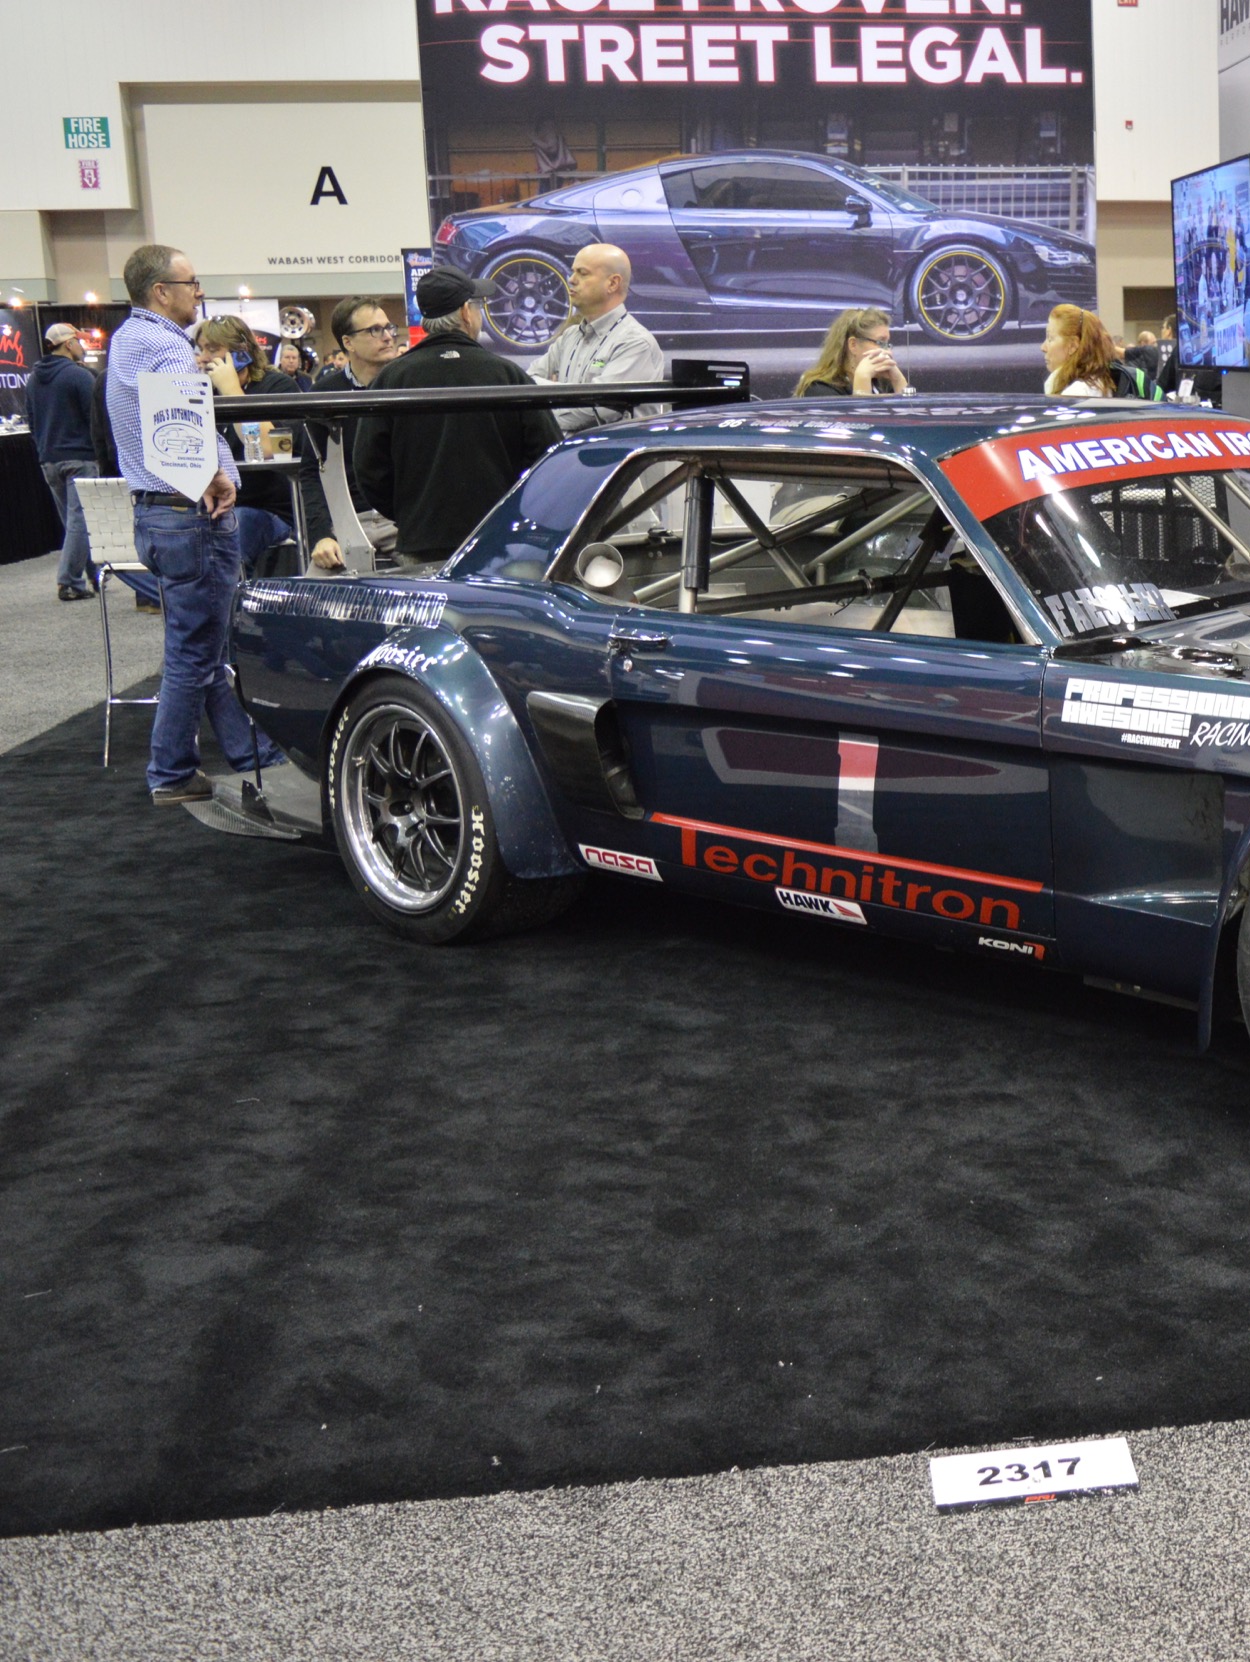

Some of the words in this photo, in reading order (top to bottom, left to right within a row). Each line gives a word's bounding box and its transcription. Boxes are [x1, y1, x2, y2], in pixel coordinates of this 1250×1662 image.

[479, 24, 789, 83] STREET
[813, 26, 1083, 84] LEGAL.
[70, 118, 102, 133] FIRE
[68, 133, 107, 148] HOSE
[310, 166, 348, 205] A
[268, 256, 313, 265] WABASH
[317, 256, 344, 264] WEST
[348, 255, 401, 264] CORRIDOR
[161, 461, 188, 469] Cincinnati,
[1016, 431, 1222, 482] AMERICAN
[1061, 700, 1192, 737] AWESOME!
[1121, 733, 1181, 749] #RACEWINREPEAT
[455, 808, 486, 915] Hoosier
[585, 847, 654, 875] nasa
[681, 825, 1021, 930] Technitron
[778, 890, 835, 915] HAWK
[978, 936, 1033, 955] KONI
[977, 1456, 1081, 1486] 2317
